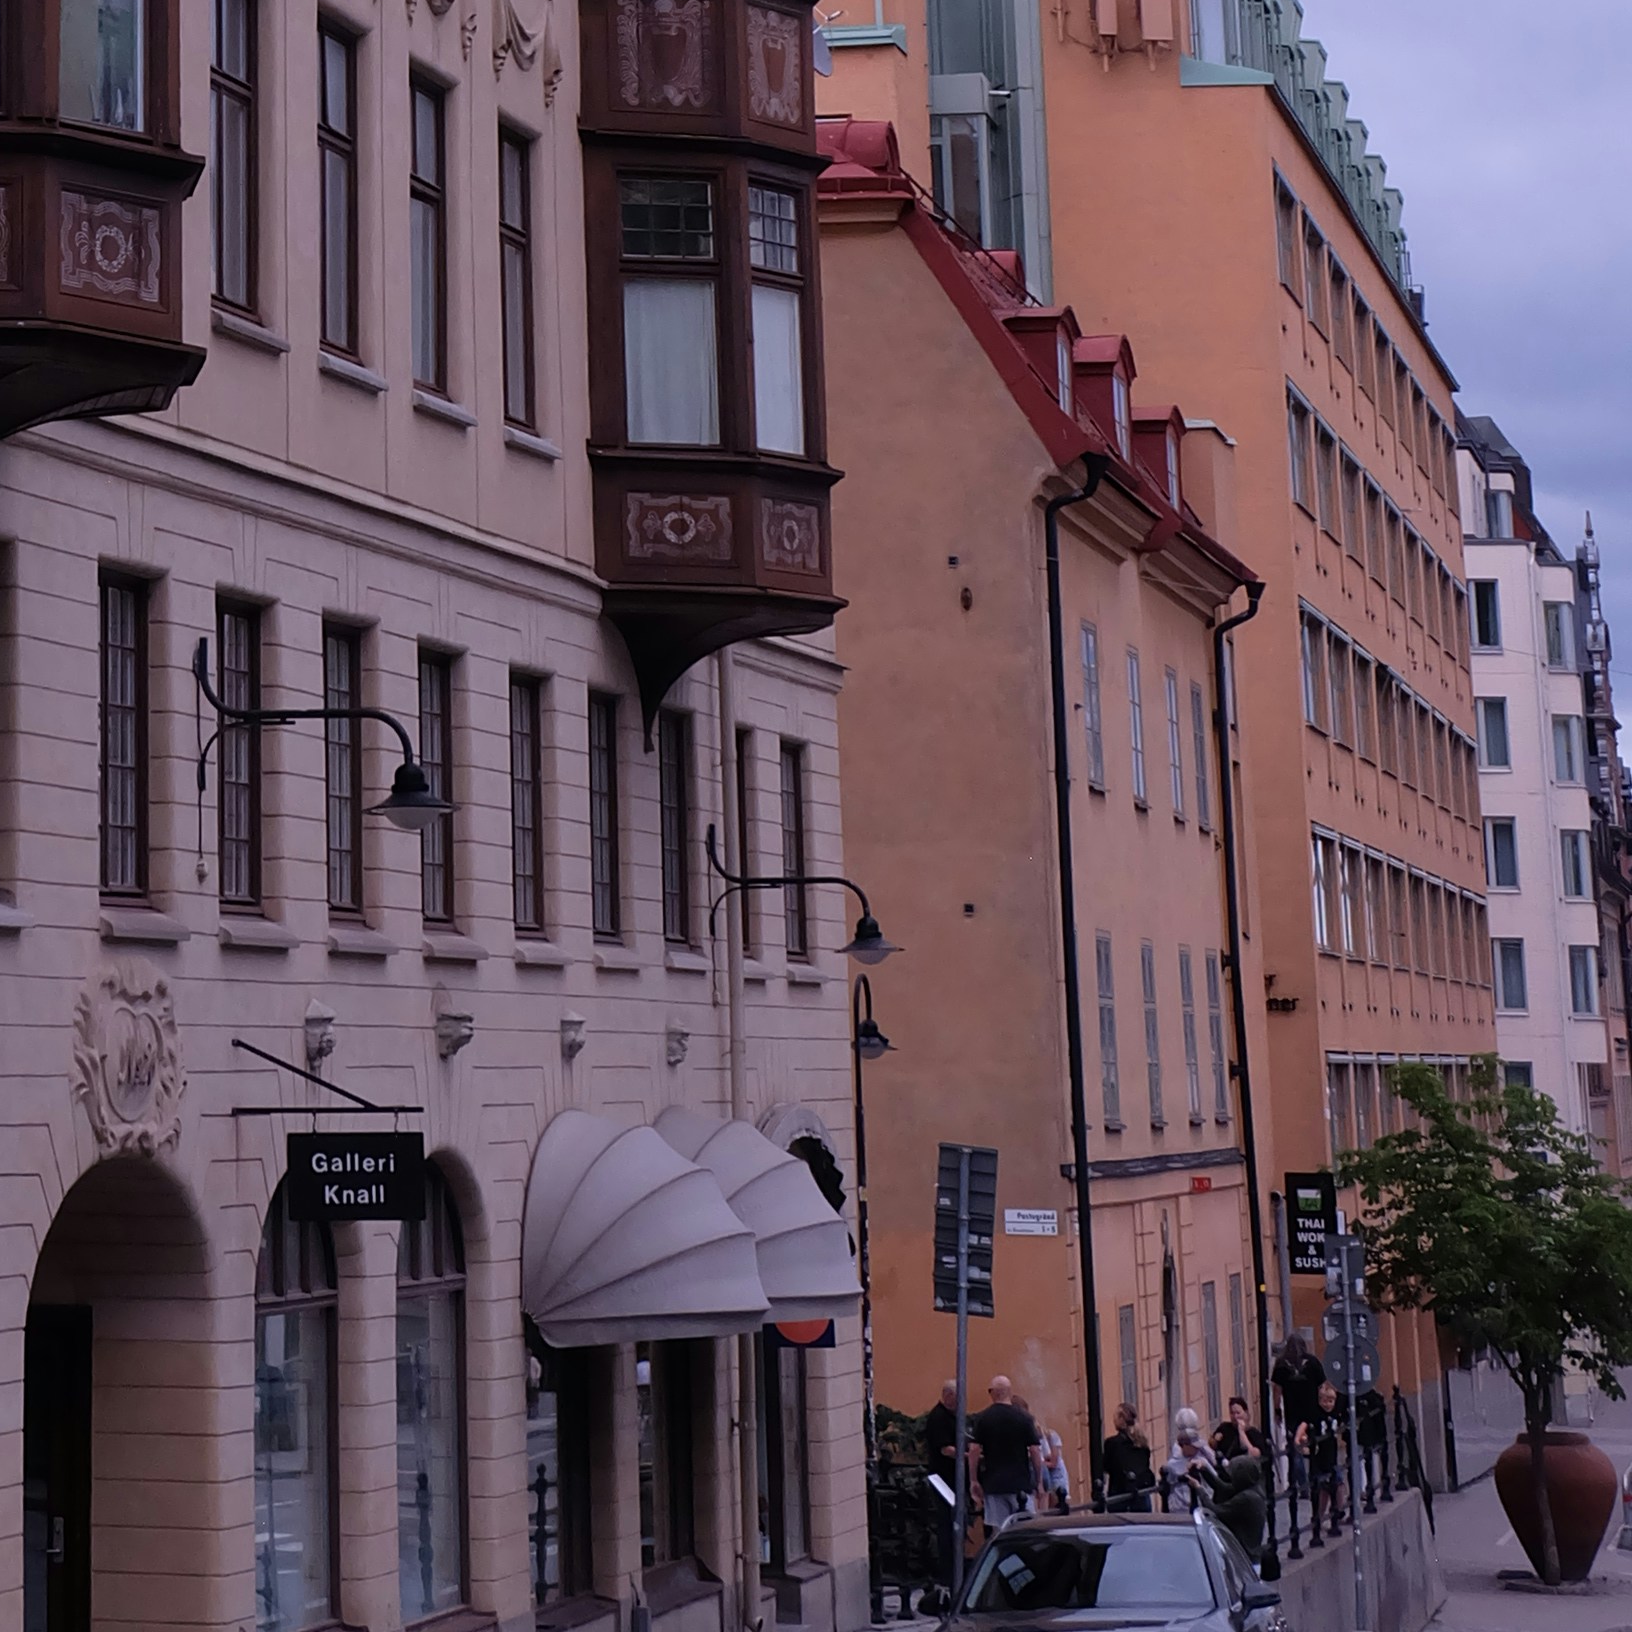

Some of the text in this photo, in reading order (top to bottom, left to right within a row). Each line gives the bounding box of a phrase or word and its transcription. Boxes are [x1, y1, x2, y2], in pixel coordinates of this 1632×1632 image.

[311, 1152, 395, 1173] Galleri
[324, 1184, 385, 1204] Knall
[1296, 1218, 1325, 1229] THAI
[1296, 1232, 1325, 1243] WOK
[1308, 1245, 1317, 1255] &
[1295, 1257, 1327, 1268] SUSH
